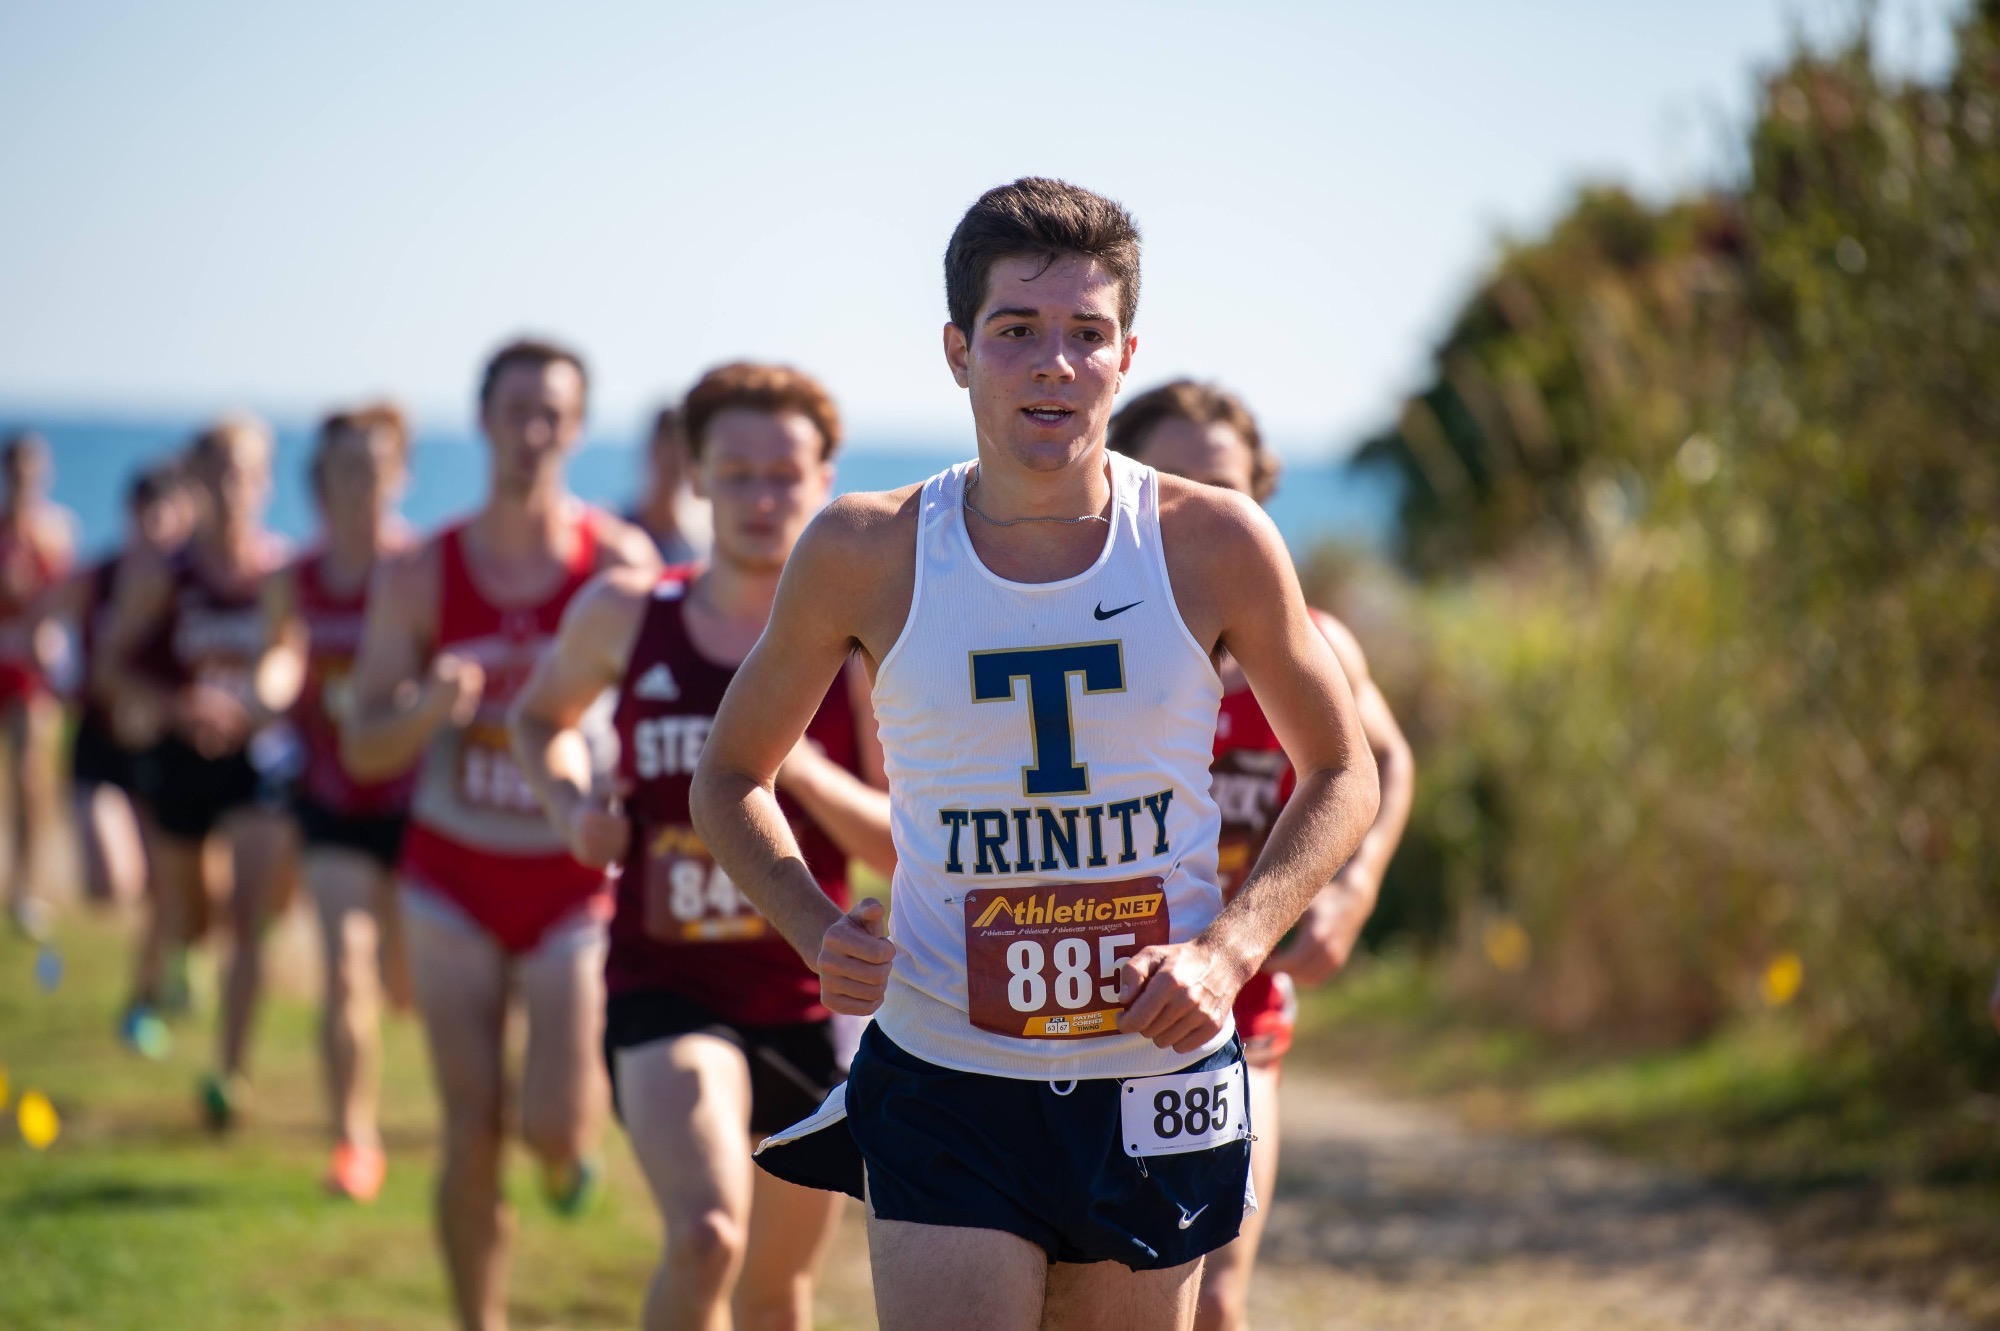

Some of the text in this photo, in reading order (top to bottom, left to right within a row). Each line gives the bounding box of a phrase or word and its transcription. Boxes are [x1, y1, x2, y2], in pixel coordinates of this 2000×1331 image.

[968, 638, 1127, 797] T
[938, 787, 1175, 875] TRINITY
[1119, 899, 1157, 916] NET
[1006, 933, 1137, 1012] 885
[1072, 1018, 1104, 1027] CORNER
[1073, 1013, 1102, 1021] PAYNES
[1153, 1082, 1229, 1139] 885
